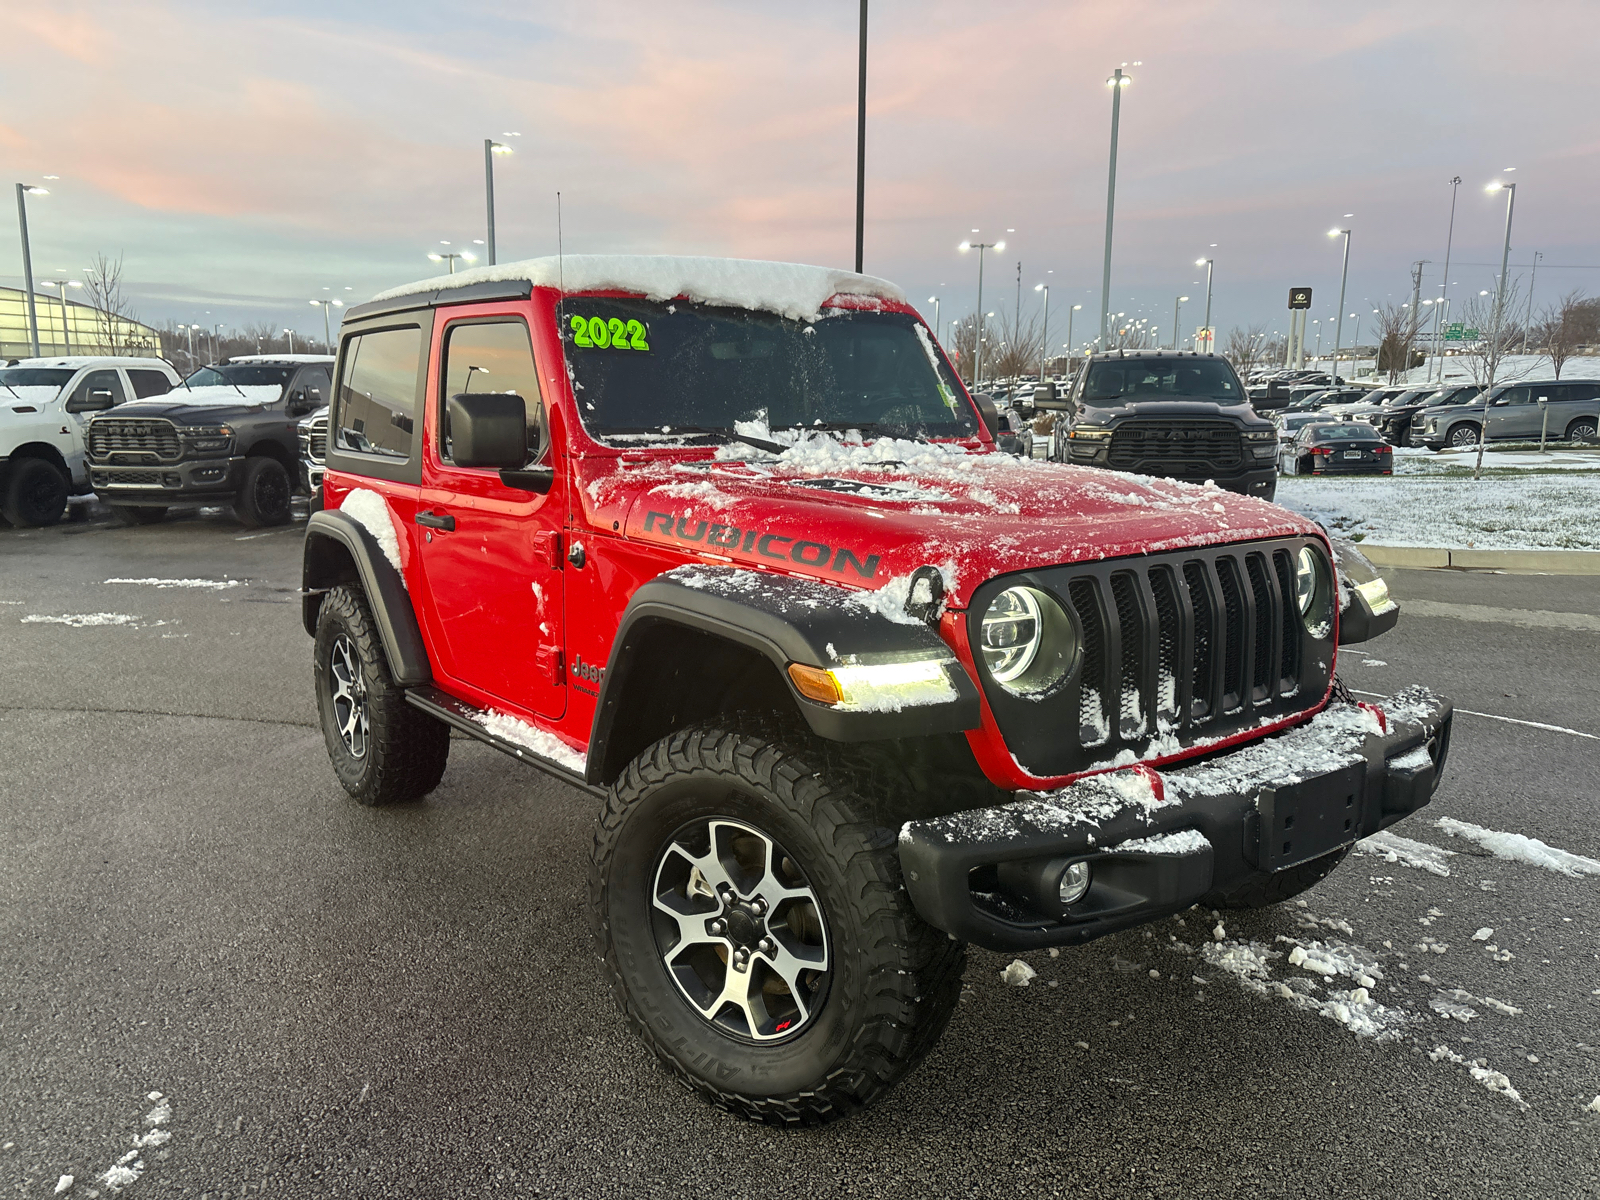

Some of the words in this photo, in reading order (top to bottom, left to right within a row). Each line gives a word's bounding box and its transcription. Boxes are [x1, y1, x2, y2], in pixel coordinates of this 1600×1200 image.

[570, 315, 650, 351] 2022
[108, 426, 152, 435] RAM
[1144, 430, 1206, 440] RAM
[643, 510, 881, 579] RUBICON
